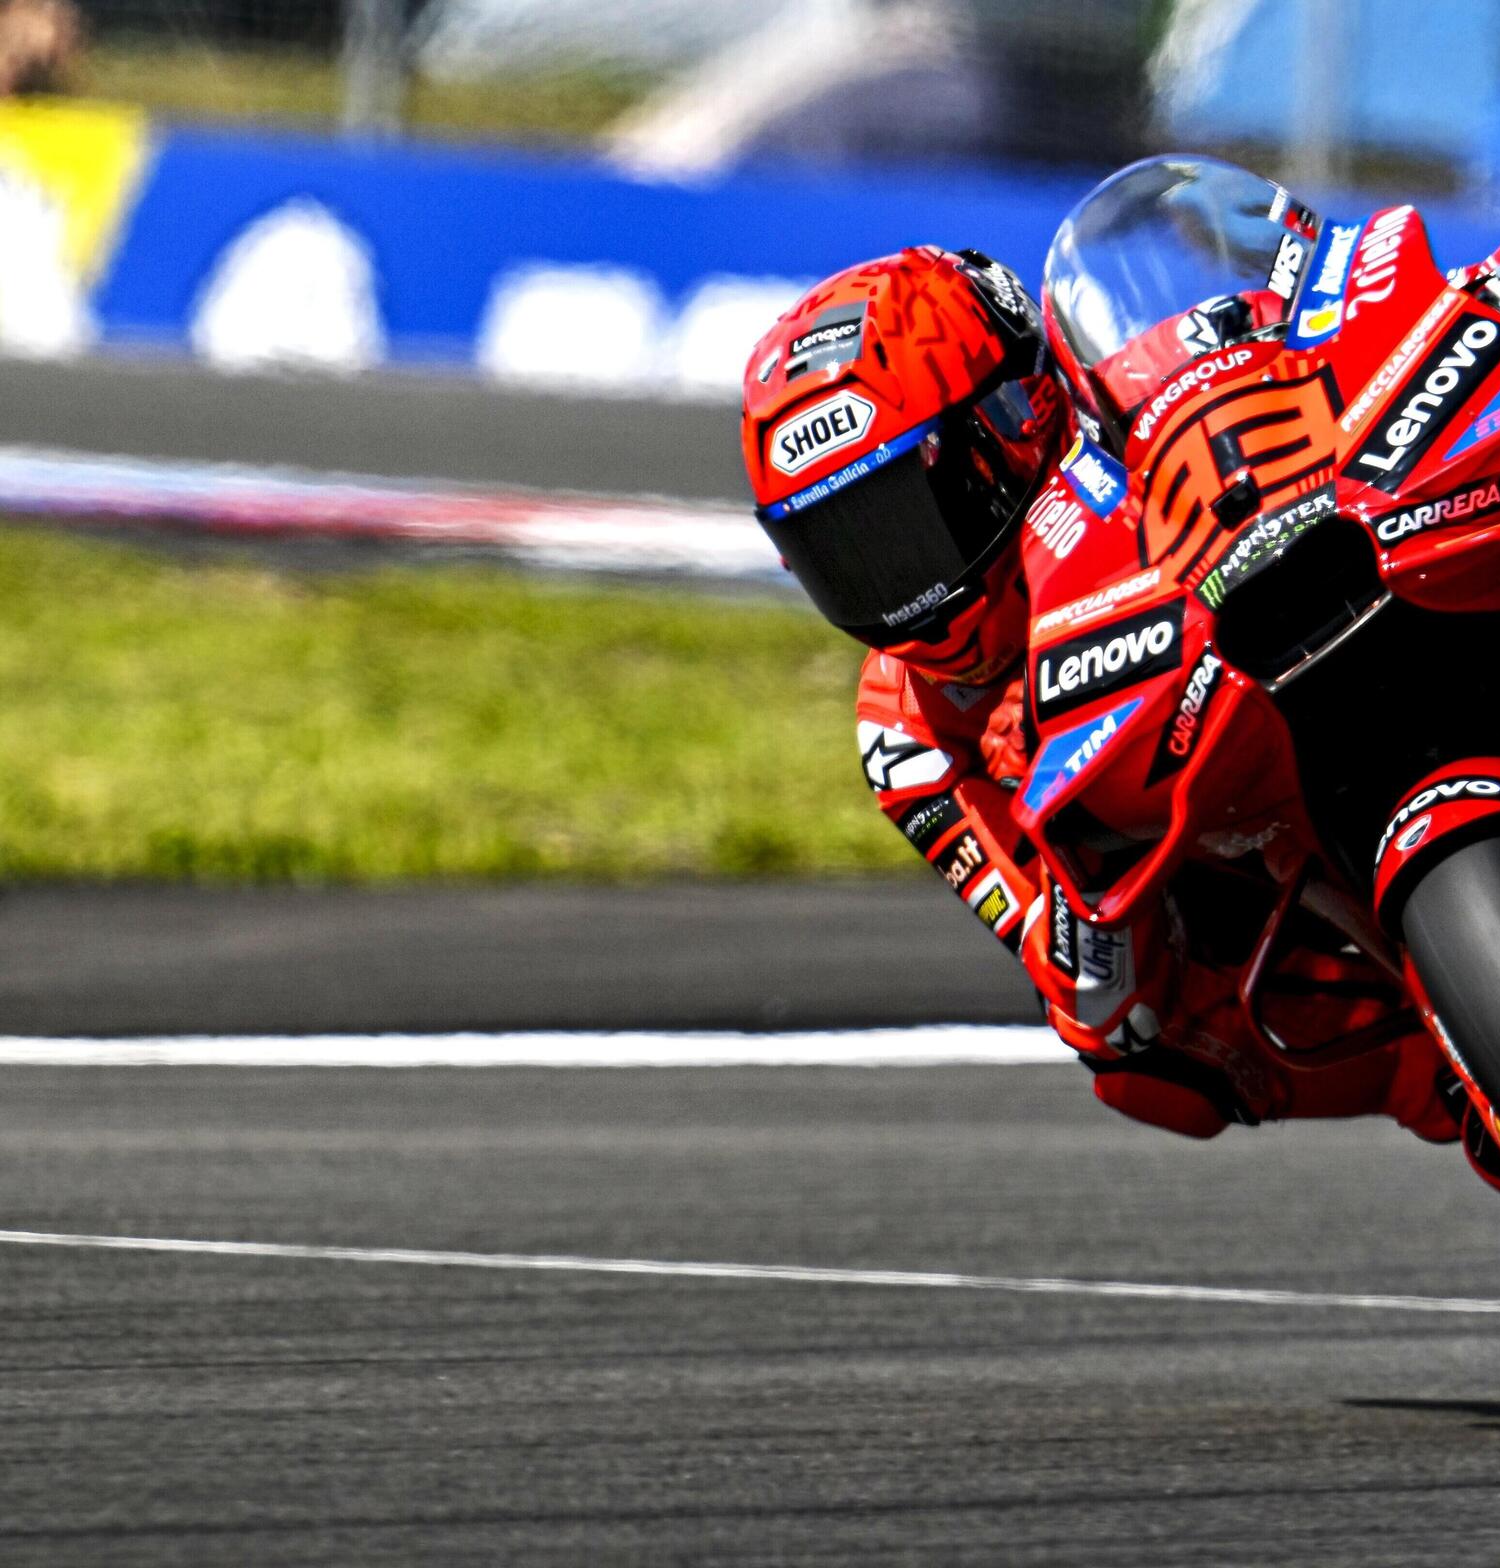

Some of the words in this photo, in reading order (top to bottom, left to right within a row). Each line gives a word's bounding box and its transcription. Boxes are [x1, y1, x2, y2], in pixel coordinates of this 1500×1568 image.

[1268, 233, 1304, 300] WRS
[793, 324, 857, 352] Lenovo
[1358, 320, 1498, 471] Lenovo
[781, 404, 858, 464] SHOEI
[790, 484, 830, 511] Estrella
[828, 462, 871, 491] Galicia
[1138, 368, 1342, 582] 93
[881, 583, 949, 627] Insta360
[1040, 621, 1174, 702] Lenovo
[1169, 653, 1222, 755] CARRERA
[1064, 714, 1118, 773] TIM
[1083, 927, 1125, 980] Unip
